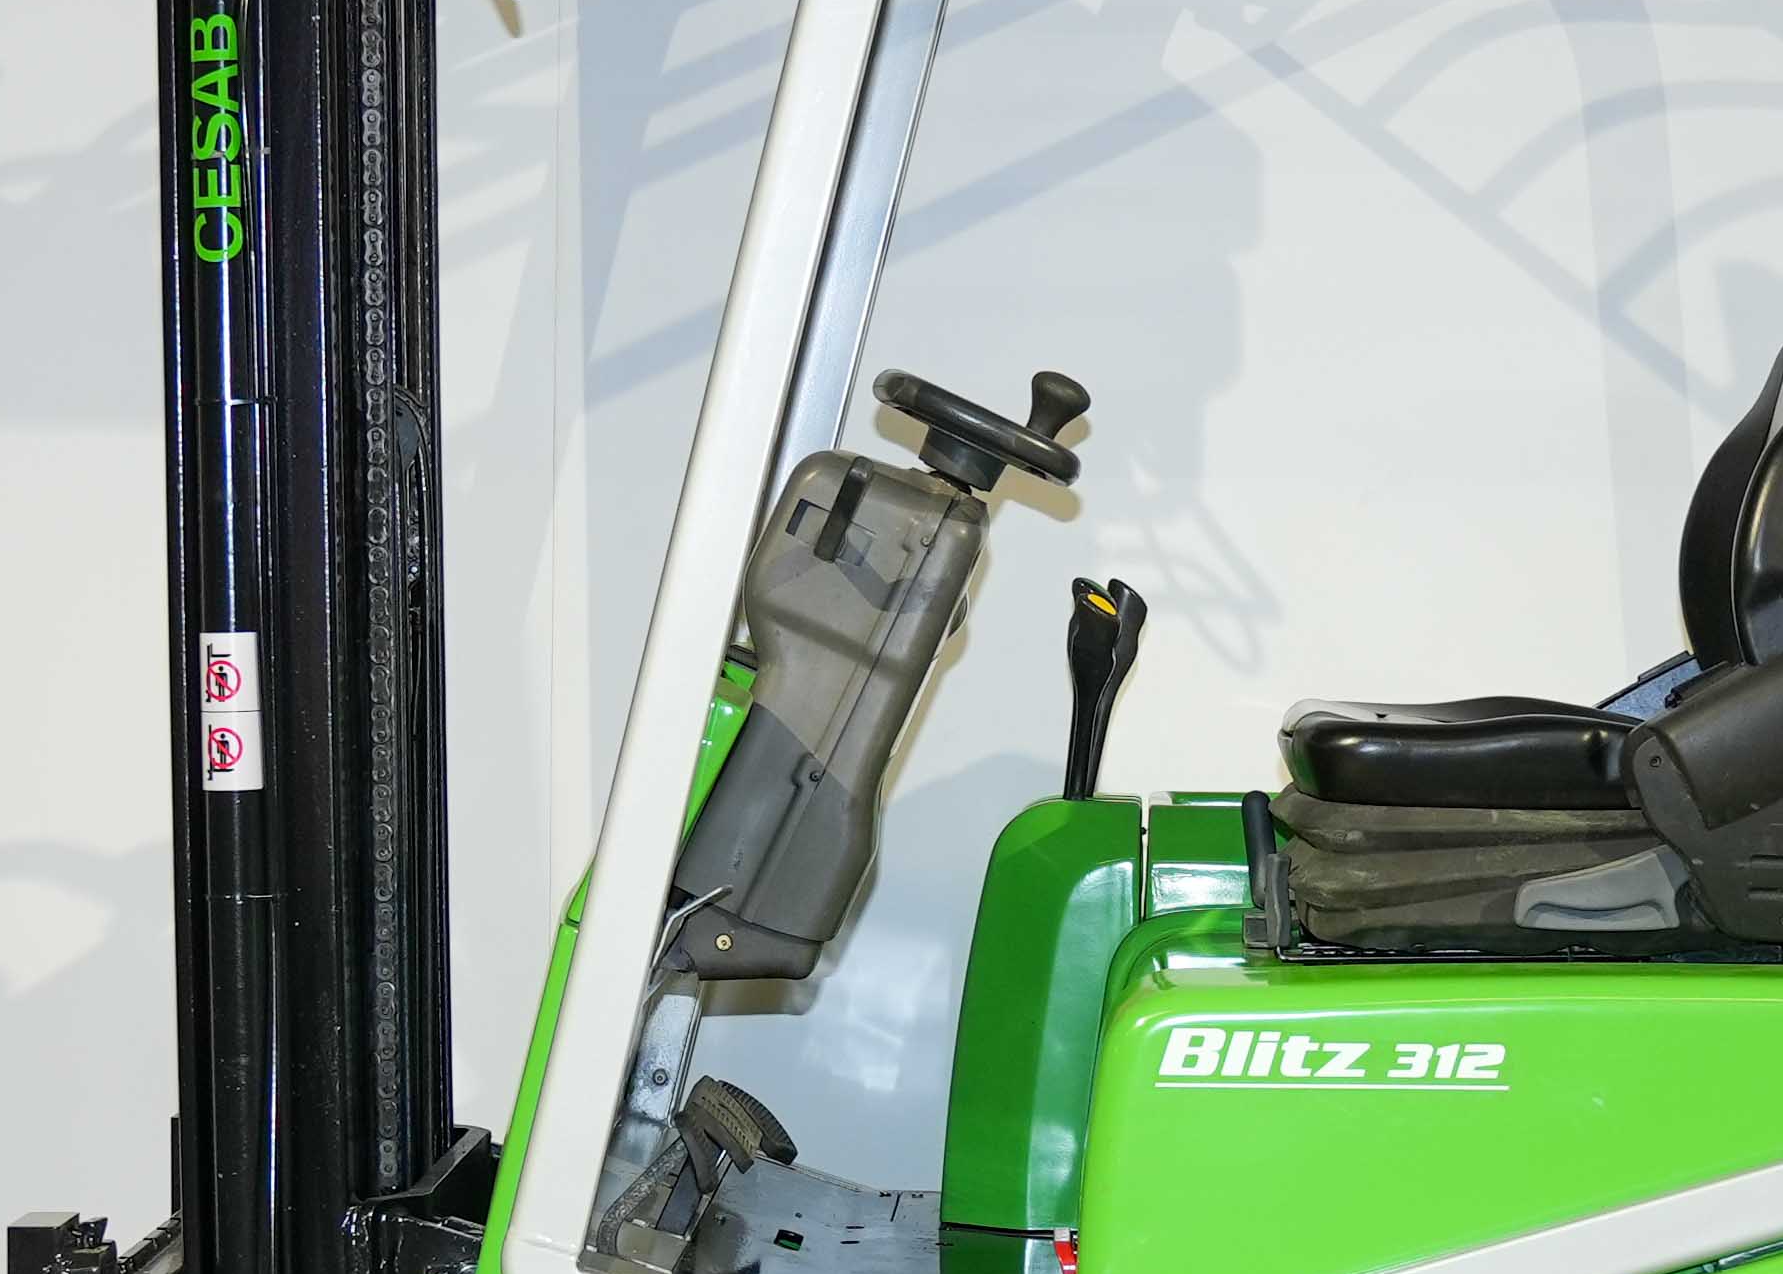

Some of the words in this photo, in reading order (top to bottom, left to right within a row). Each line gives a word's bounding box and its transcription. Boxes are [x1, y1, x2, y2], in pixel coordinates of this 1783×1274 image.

[190, 13, 243, 263] CESAB
[1158, 1027, 1371, 1078] Blitz
[1387, 1043, 1506, 1079] 312
